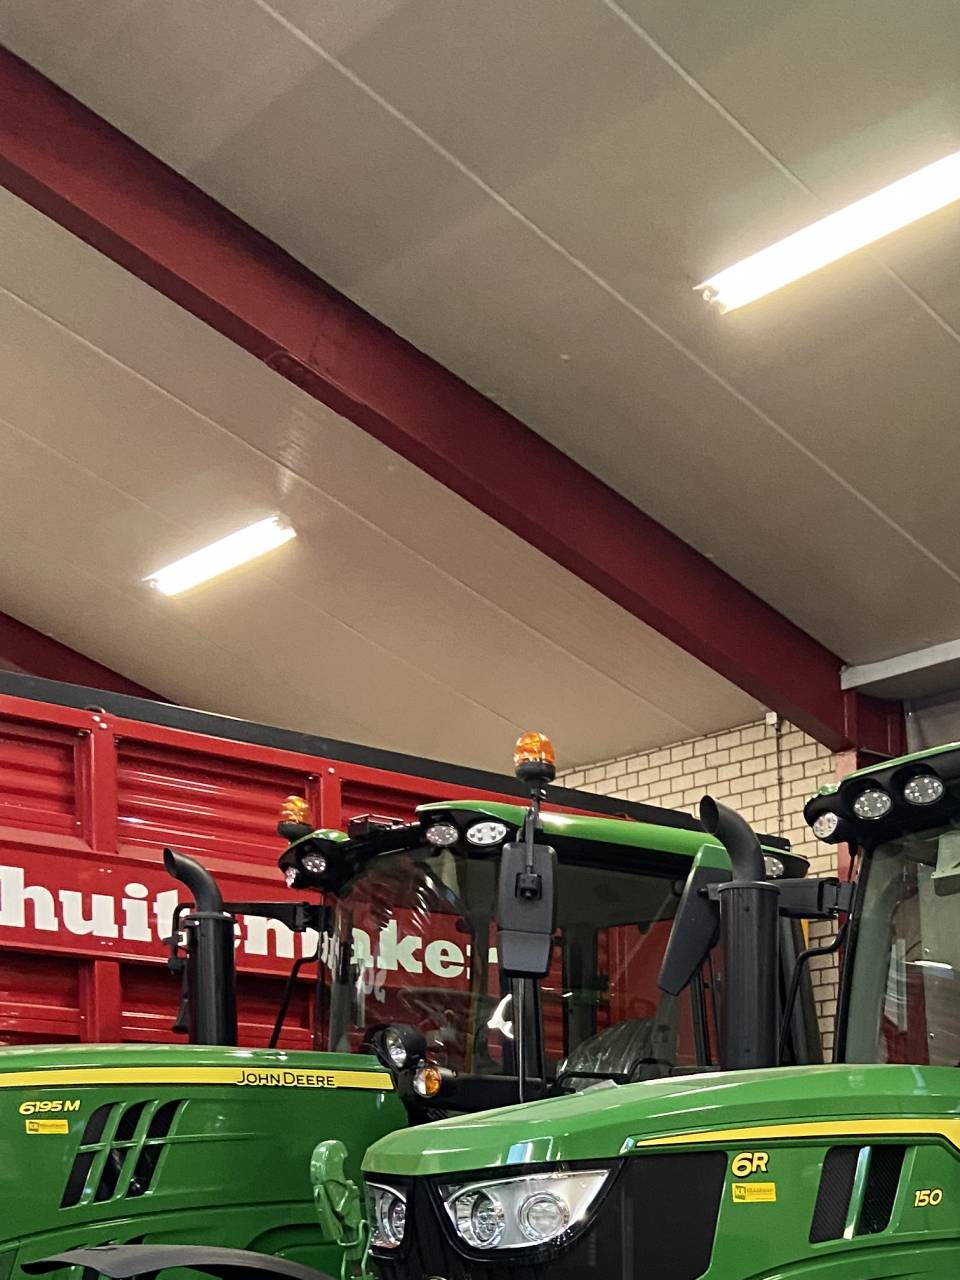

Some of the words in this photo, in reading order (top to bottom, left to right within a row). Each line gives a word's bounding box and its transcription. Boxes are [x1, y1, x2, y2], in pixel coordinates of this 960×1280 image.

[237, 1070, 280, 1084] JOHN
[283, 1072, 335, 1086] DEERE
[731, 1152, 769, 1178] 6R
[914, 1188, 943, 1207] 150
